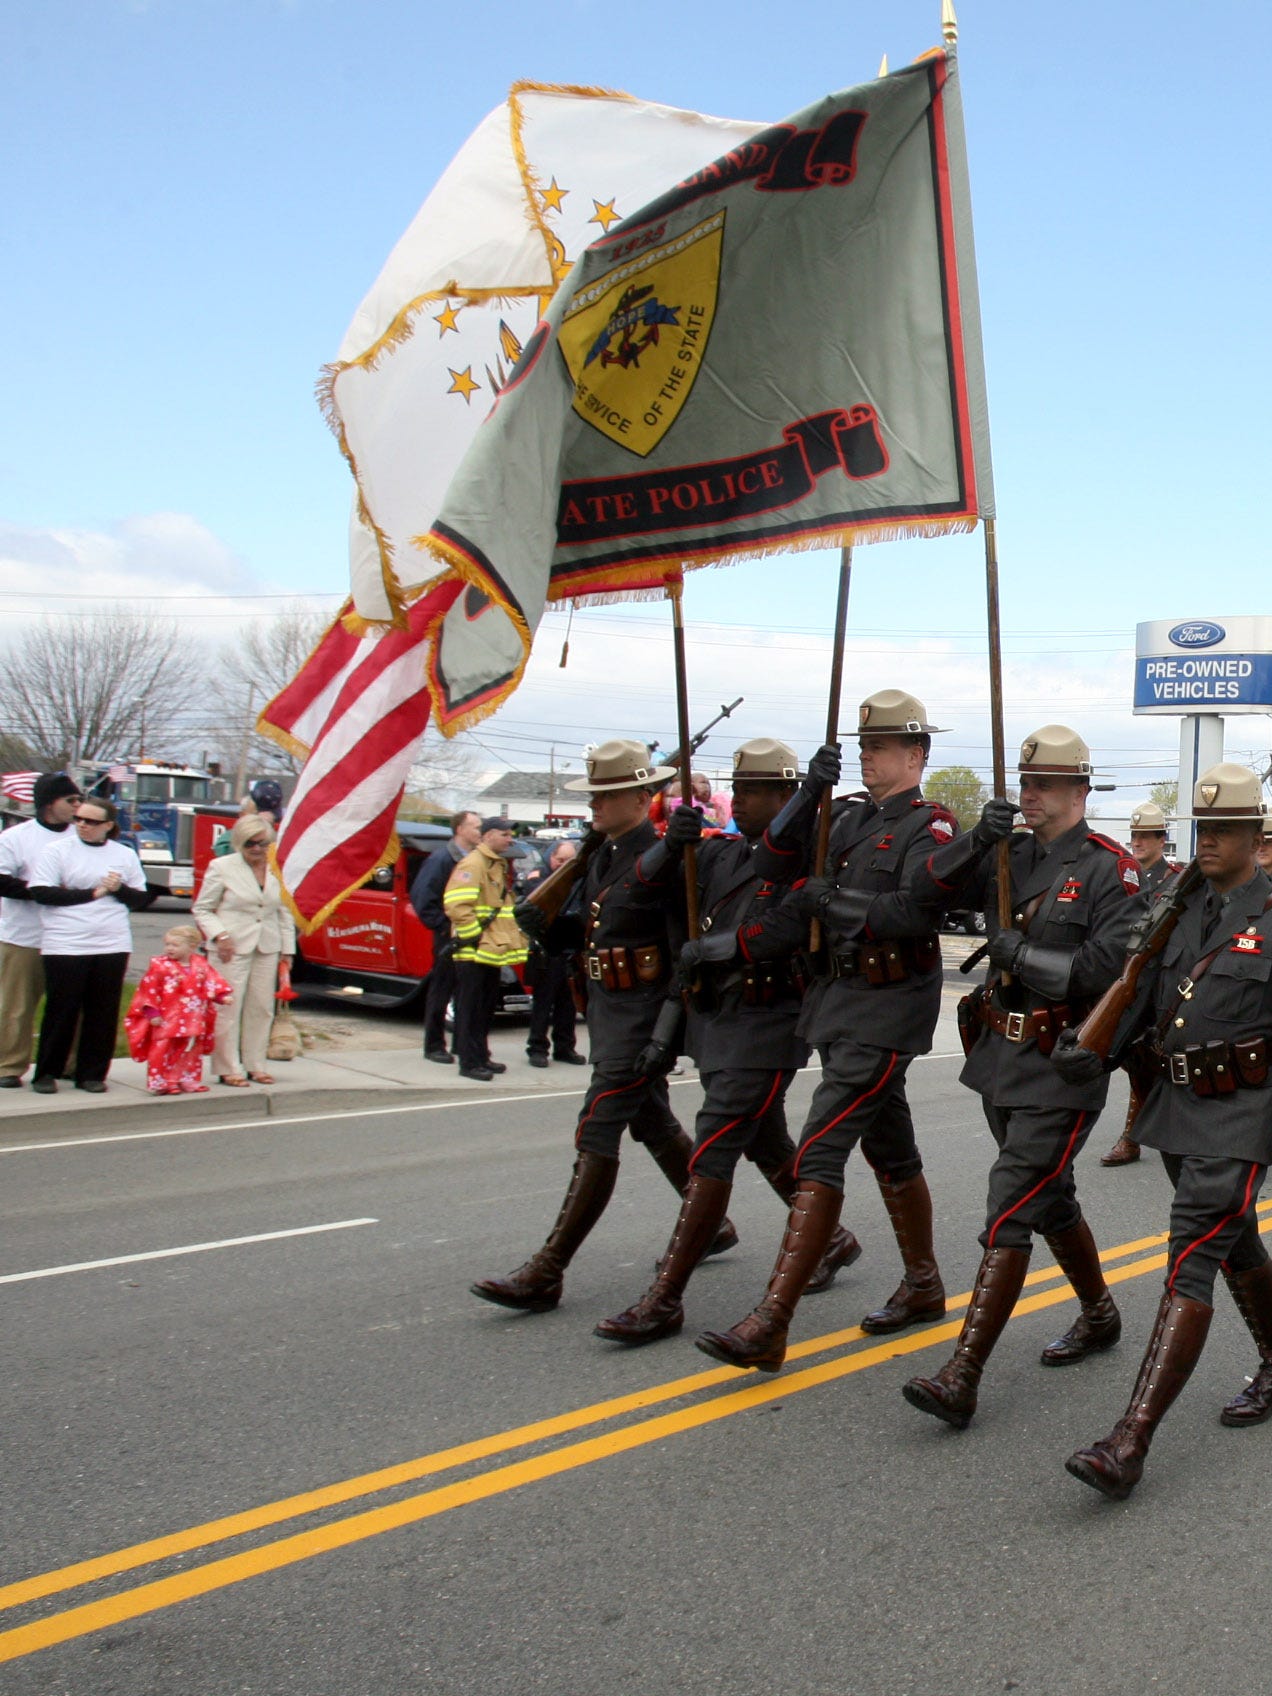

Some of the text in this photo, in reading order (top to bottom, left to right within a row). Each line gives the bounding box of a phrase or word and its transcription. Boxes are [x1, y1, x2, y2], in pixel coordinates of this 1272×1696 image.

[606, 307, 646, 336] HOPE
[643, 304, 705, 426] OF THE STATE
[647, 460, 785, 514] POLICE
[1179, 626, 1211, 642] Ford
[1146, 660, 1252, 679] PRE-OWNED
[1153, 681, 1240, 699] VEHICLES
